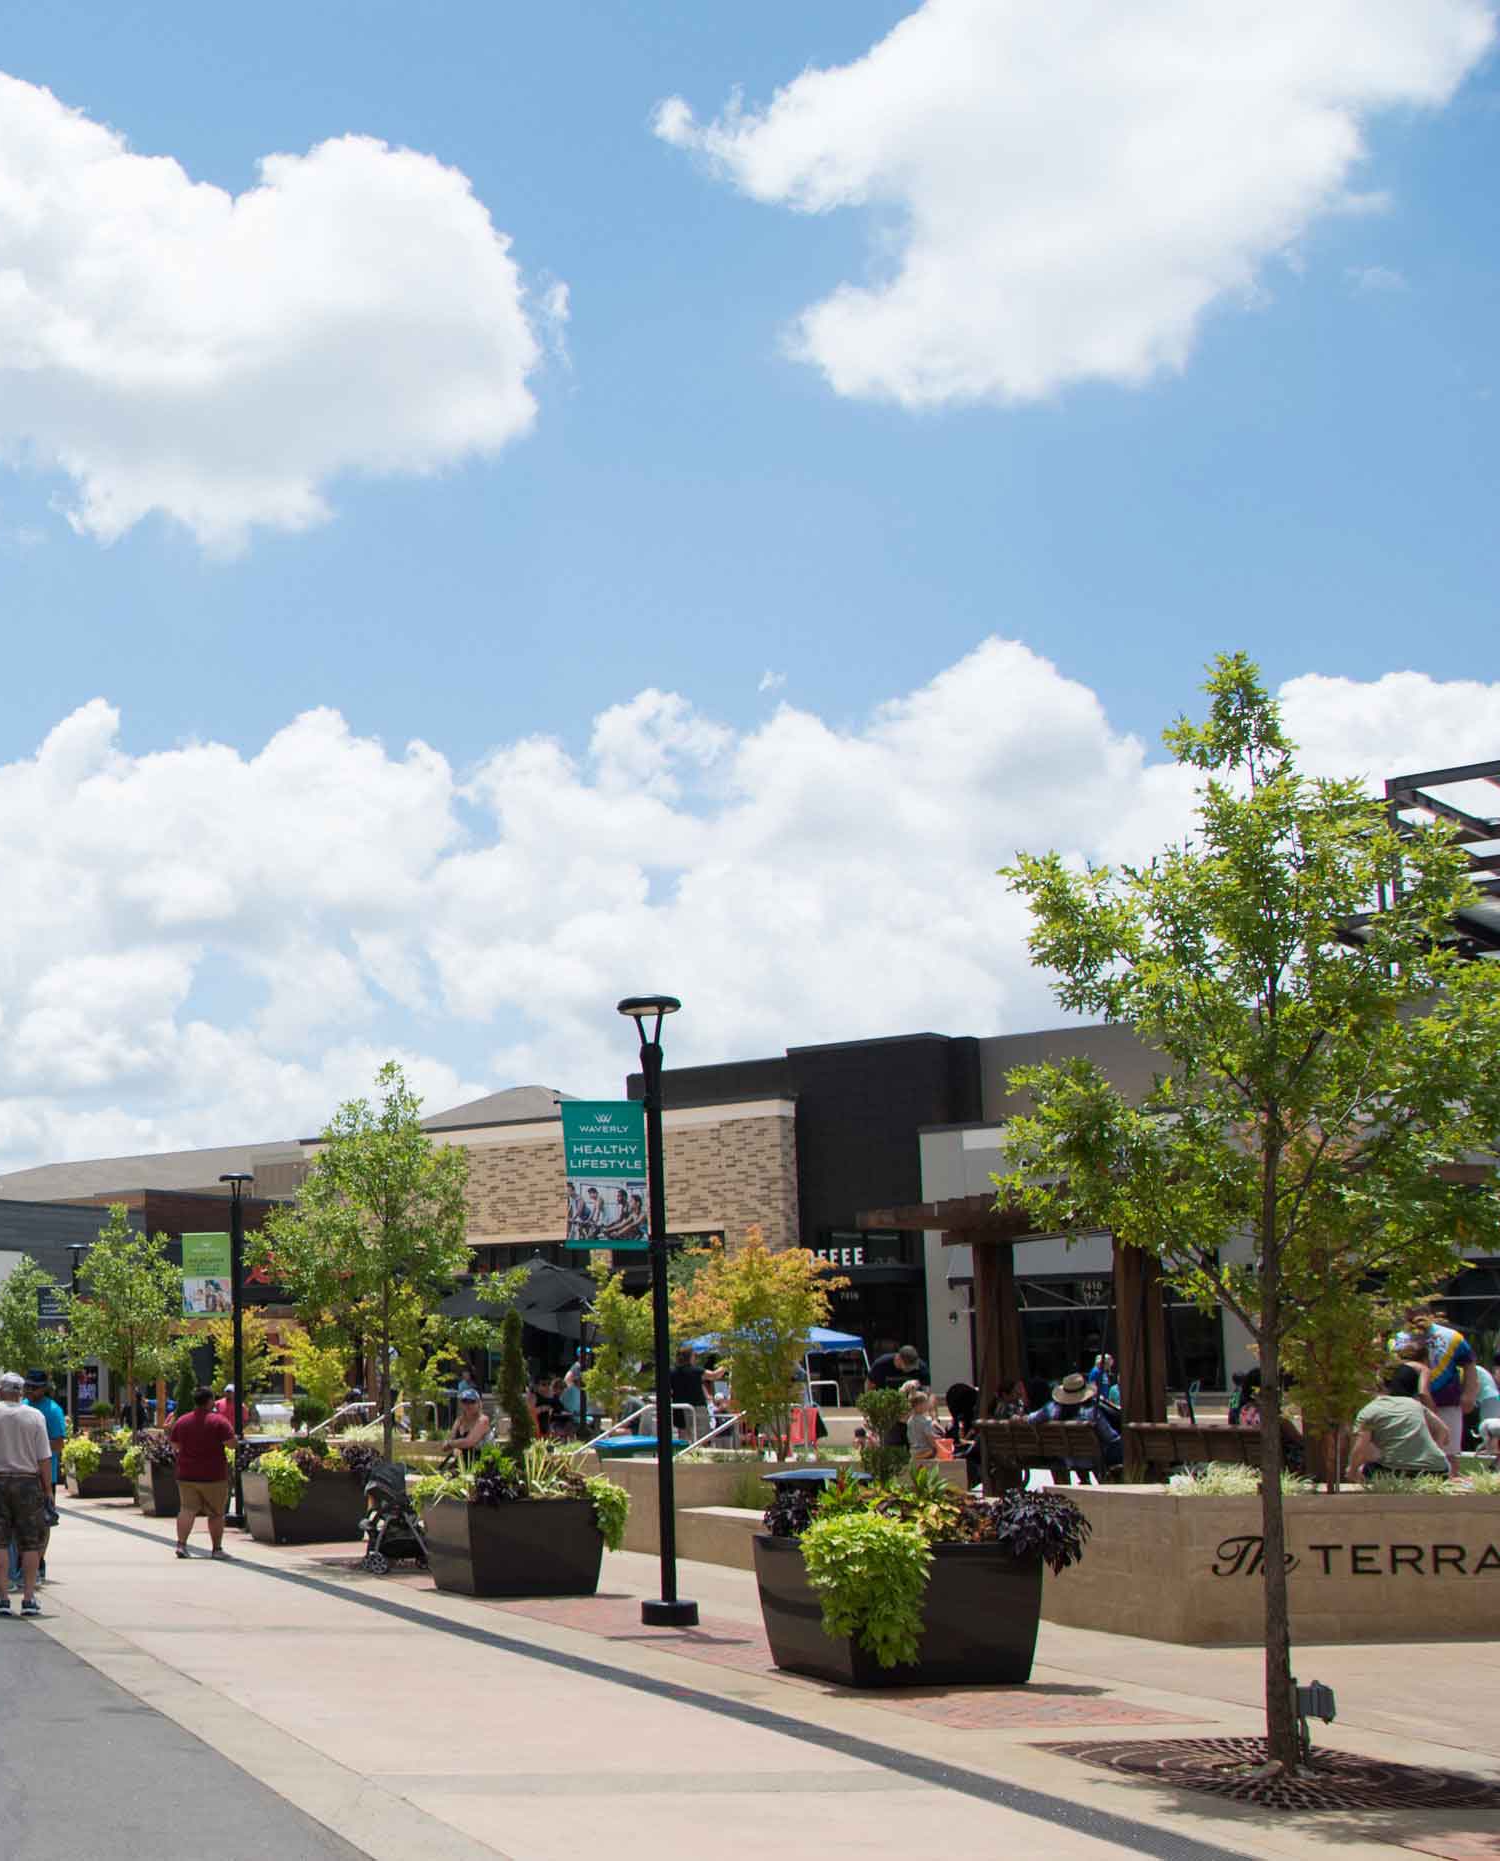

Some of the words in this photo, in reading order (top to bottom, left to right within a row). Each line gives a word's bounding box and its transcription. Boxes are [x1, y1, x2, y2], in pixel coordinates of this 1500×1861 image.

[580, 1125, 629, 1134] WAVERLY
[573, 1144, 637, 1155] HEALTHY
[570, 1159, 642, 1169] LIFESTYLE
[1308, 1544, 1500, 1575] TERRA
